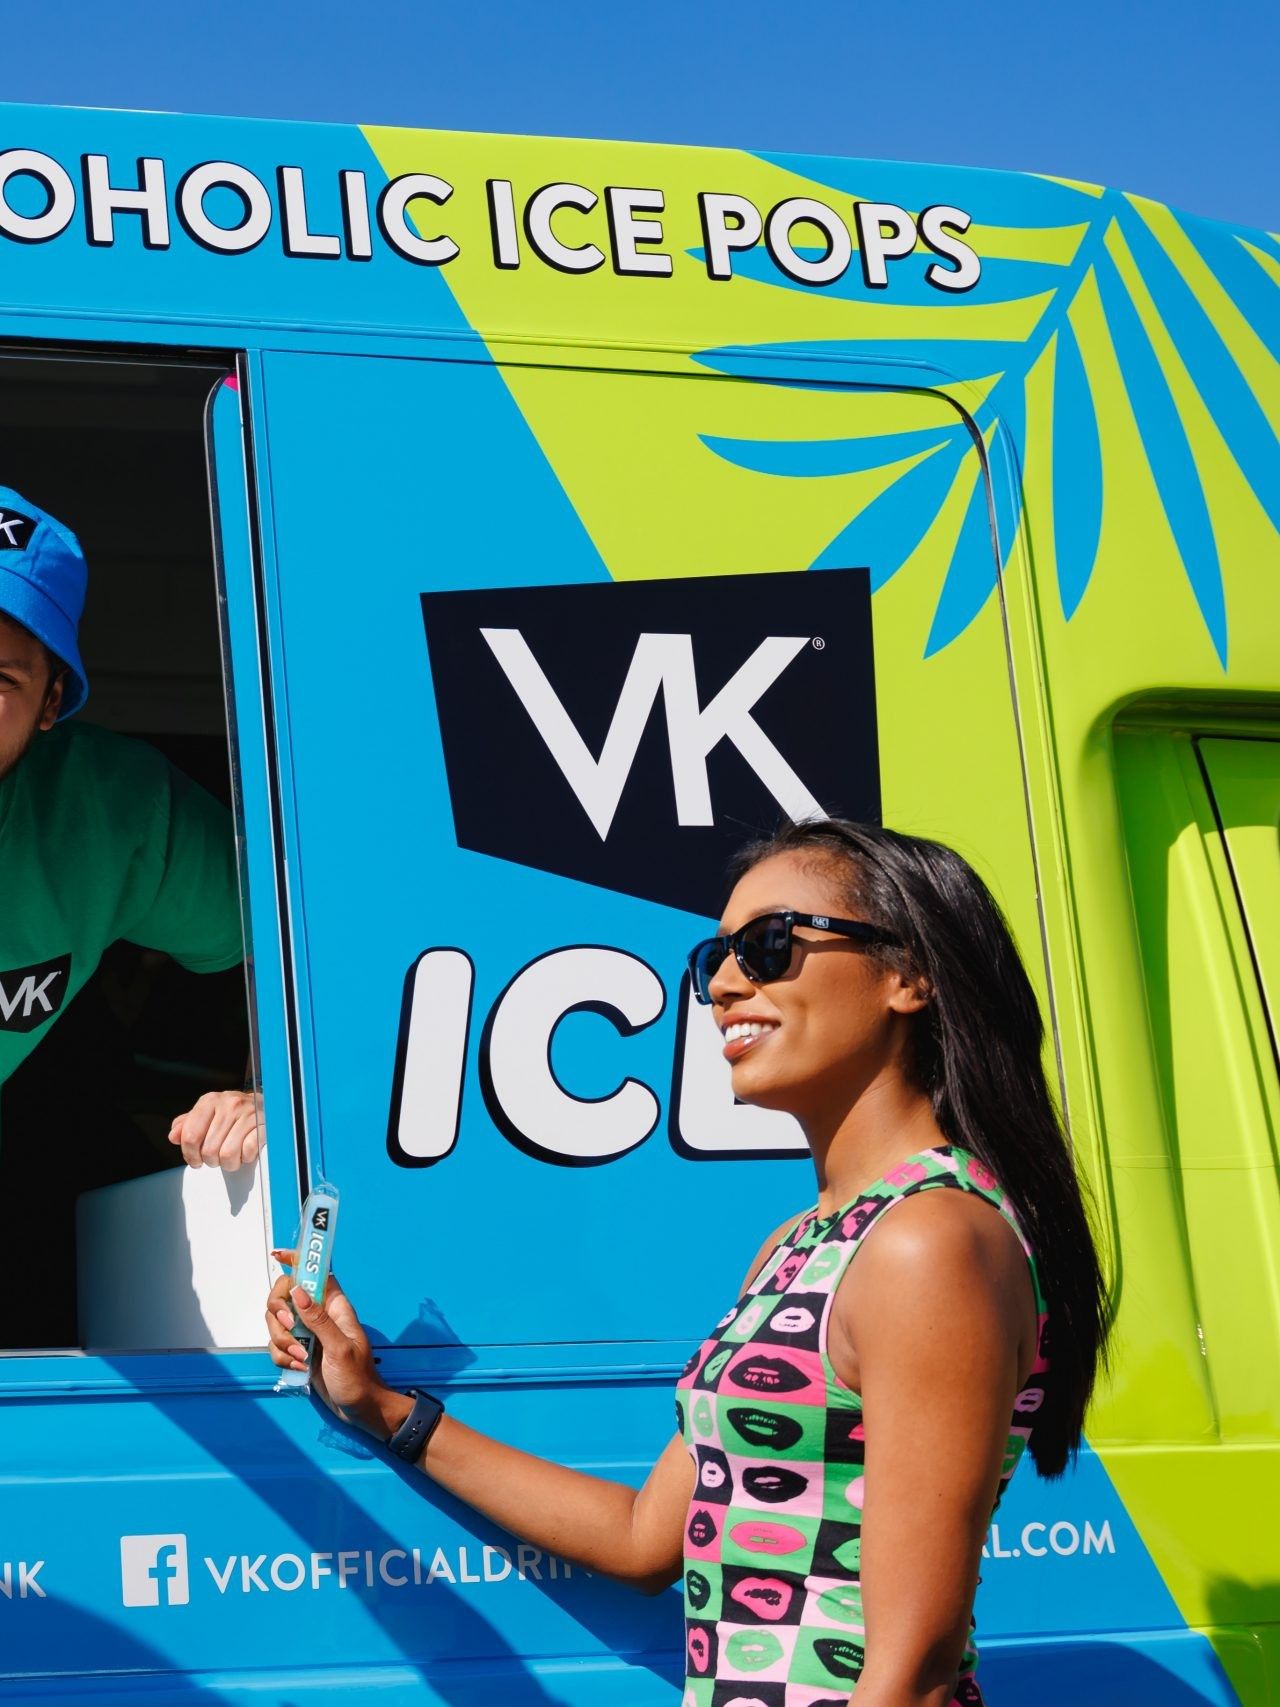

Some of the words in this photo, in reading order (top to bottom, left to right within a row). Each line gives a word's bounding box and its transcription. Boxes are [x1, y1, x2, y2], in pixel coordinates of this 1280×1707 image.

[486, 179, 673, 278] ICE
[697, 191, 981, 293] POPS
[315, 1211, 328, 1228] VK
[306, 1232, 324, 1274] ICES
[982, 1519, 1116, 1558] L.COM
